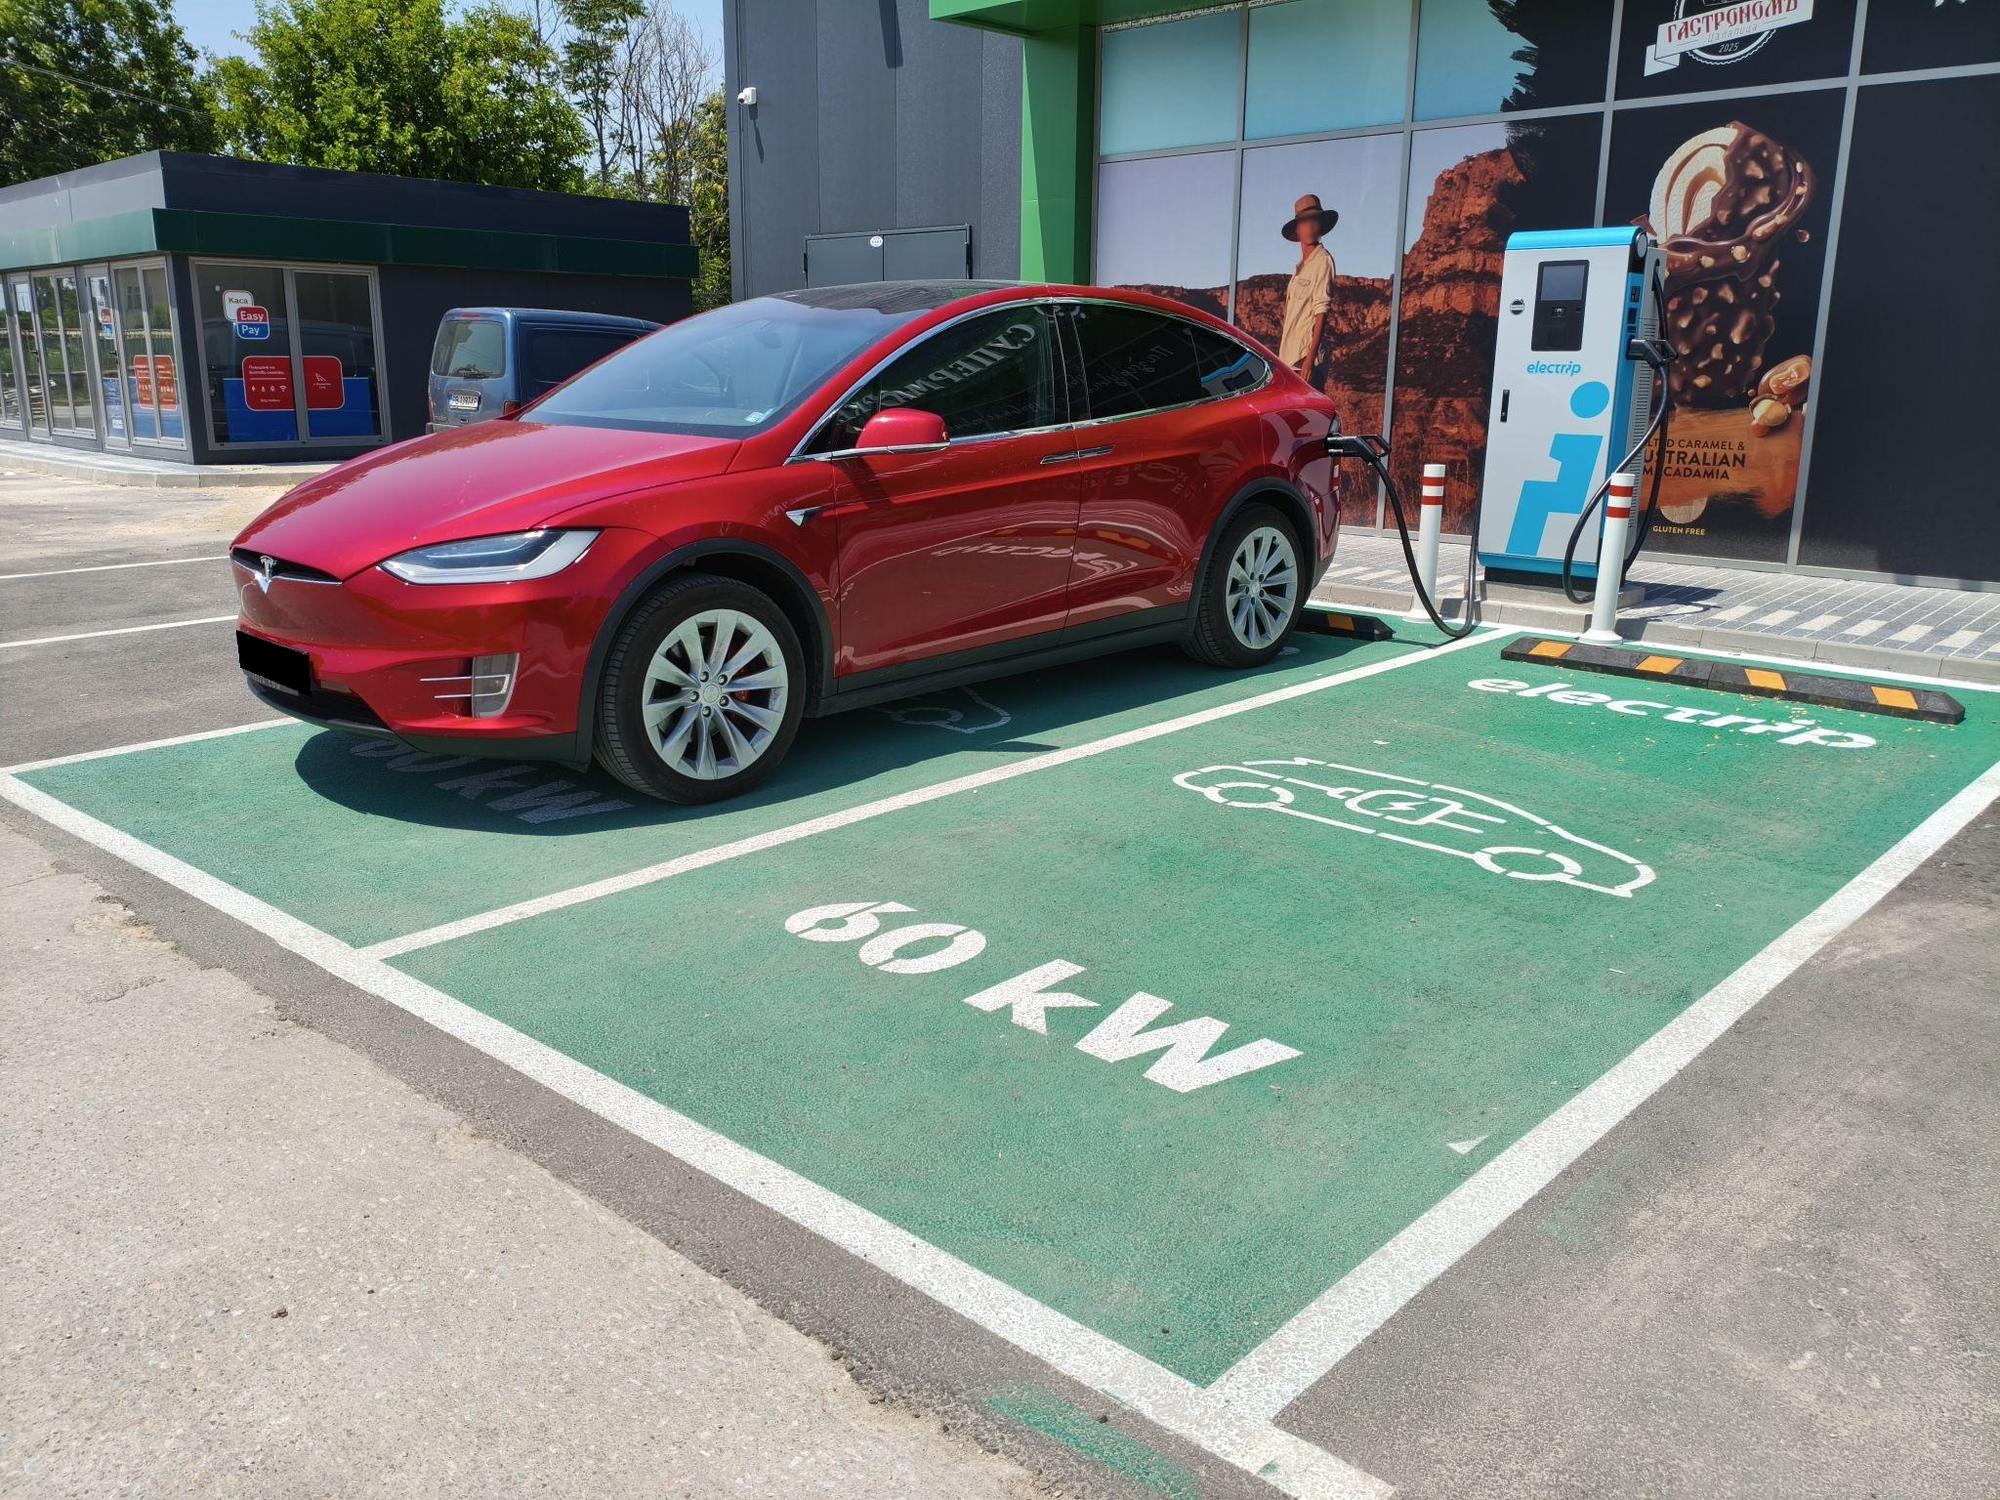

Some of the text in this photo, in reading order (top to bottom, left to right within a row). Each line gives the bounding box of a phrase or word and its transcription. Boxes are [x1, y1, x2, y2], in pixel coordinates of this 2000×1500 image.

[240, 310, 264, 322] Easy
[241, 325, 260, 336] Pay
[1526, 361, 1582, 376] electrip
[1678, 440, 1734, 451] CARAMEL
[1737, 441, 1745, 451] &
[1642, 465, 1730, 480] MCADAMIA
[1652, 525, 1706, 536] GLUTEN FREE
[1467, 678, 1878, 749] electrip
[784, 901, 987, 974] 60
